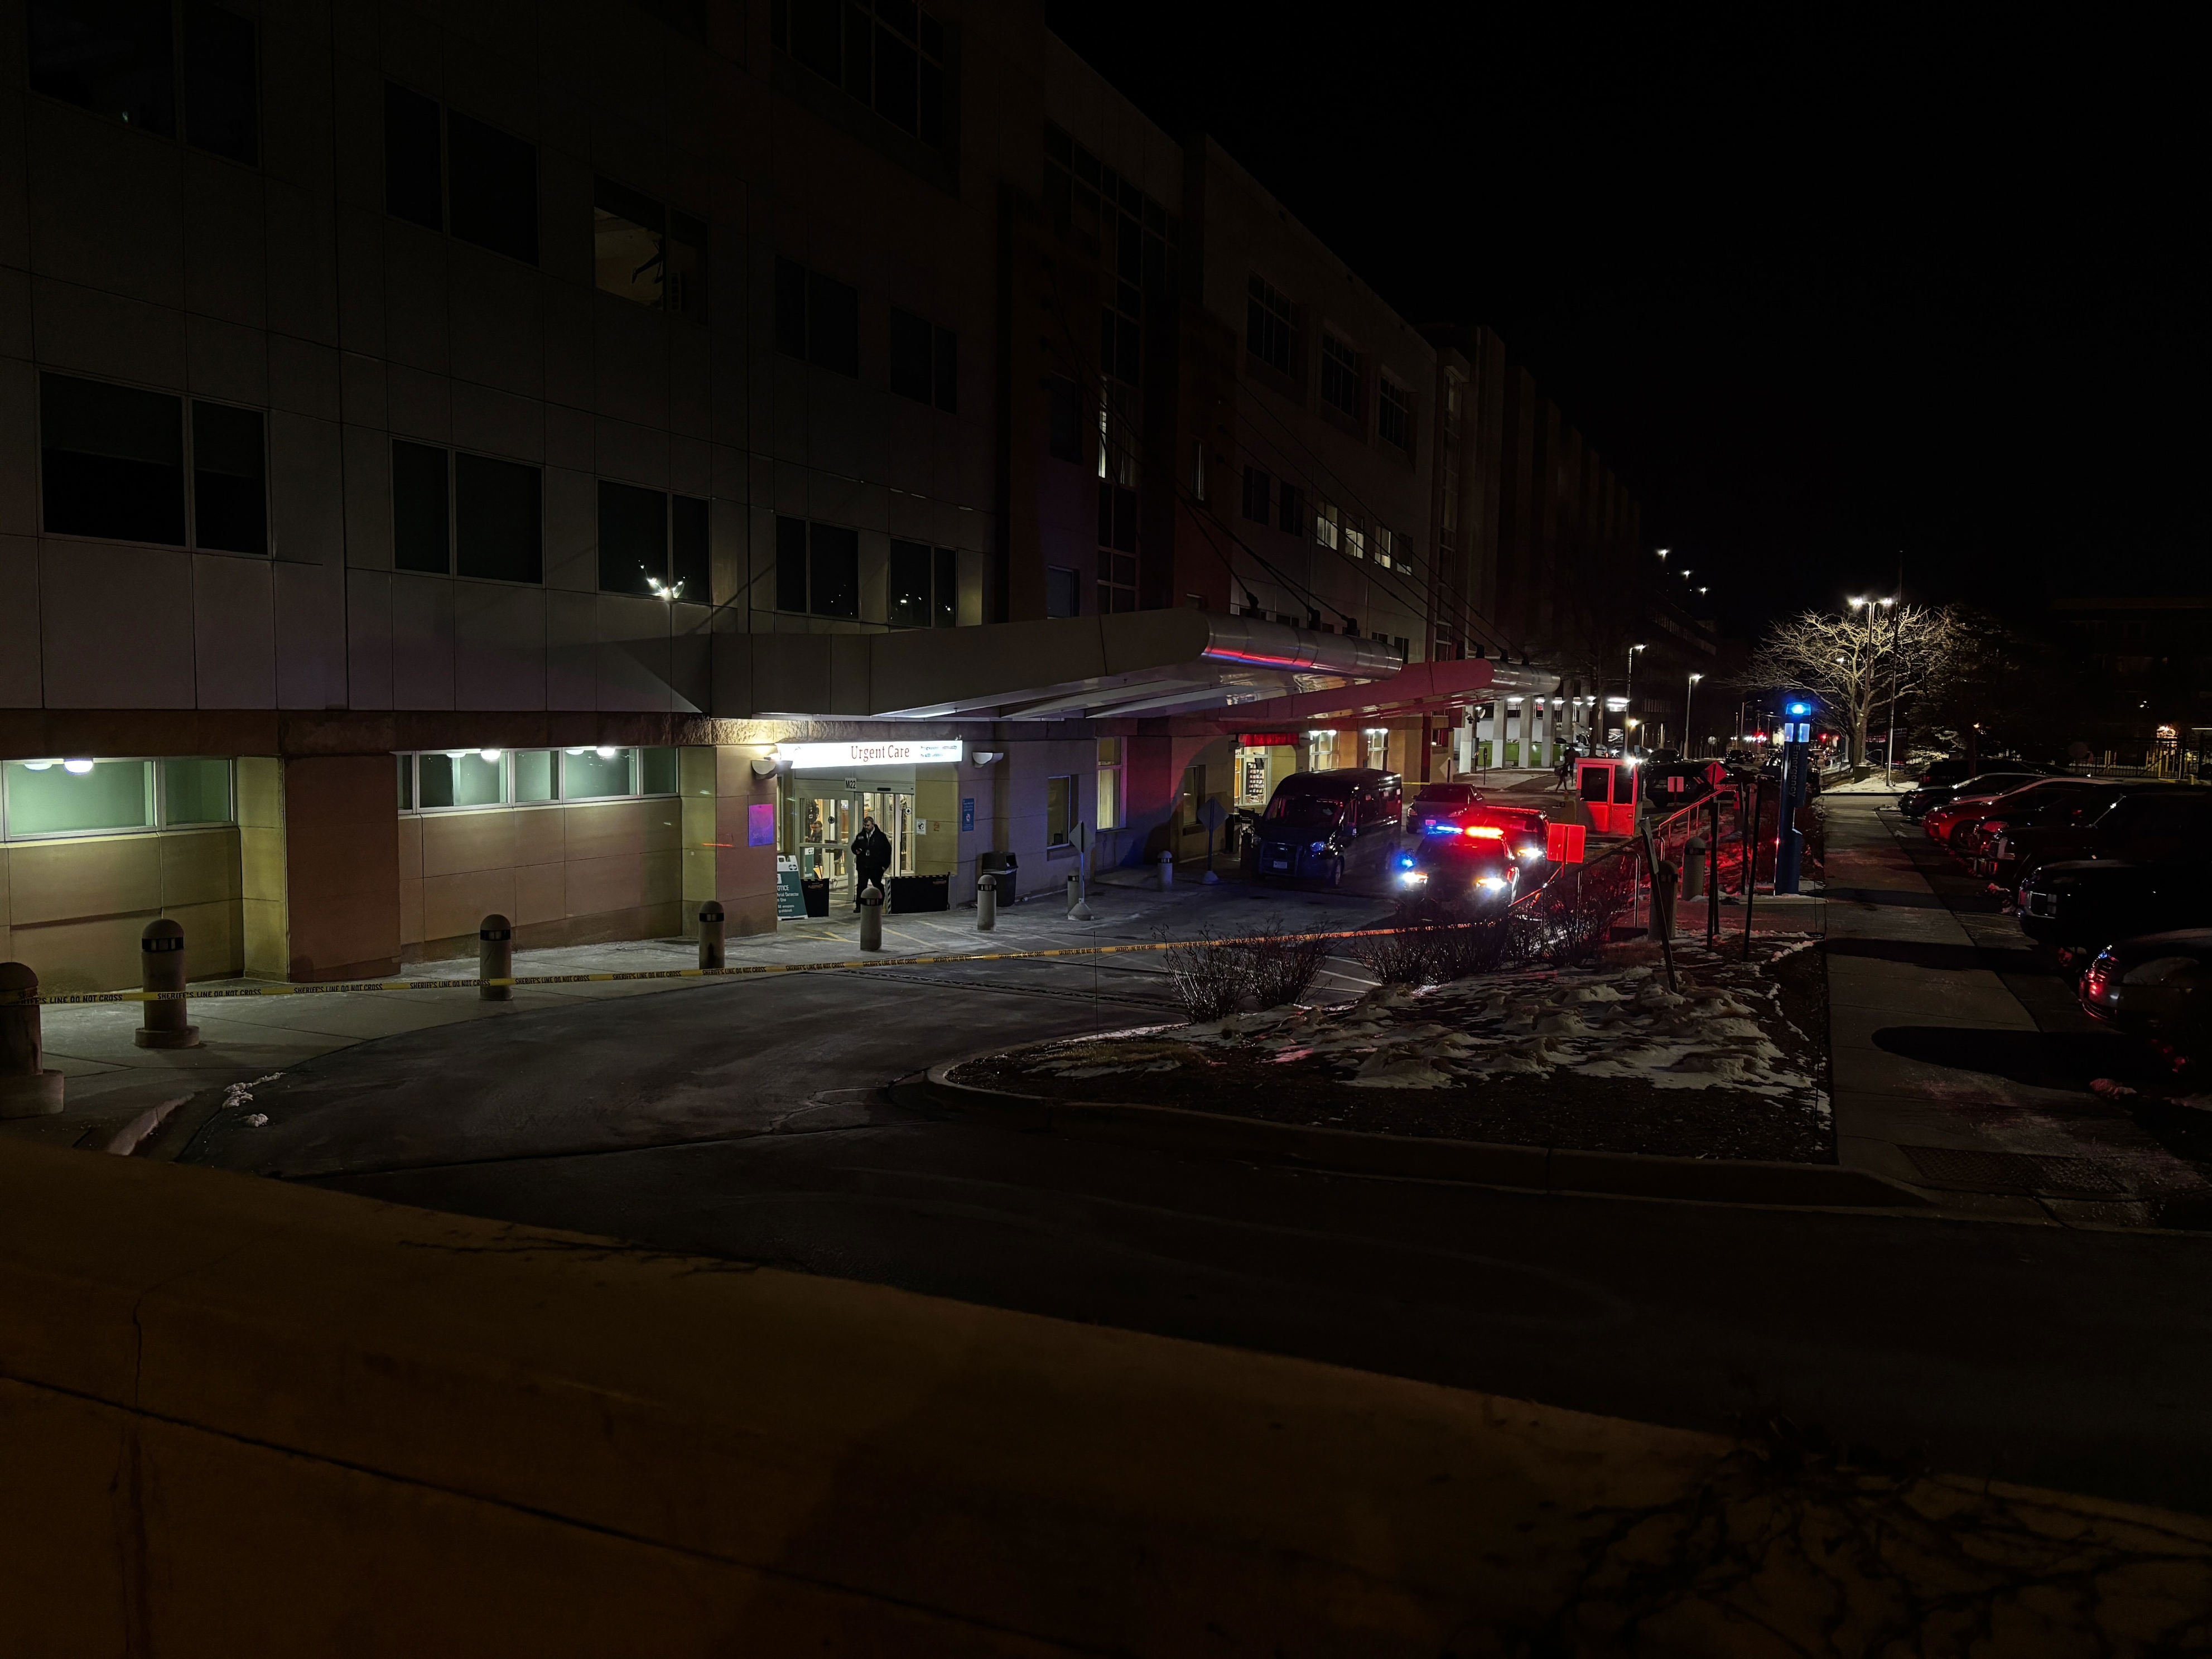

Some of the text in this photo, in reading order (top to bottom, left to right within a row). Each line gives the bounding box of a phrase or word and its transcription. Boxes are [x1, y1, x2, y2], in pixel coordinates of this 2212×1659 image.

[851, 745, 909, 761] Urgent Care
[1789, 745, 1801, 797] Emergency
[846, 780, 856, 789] M22
